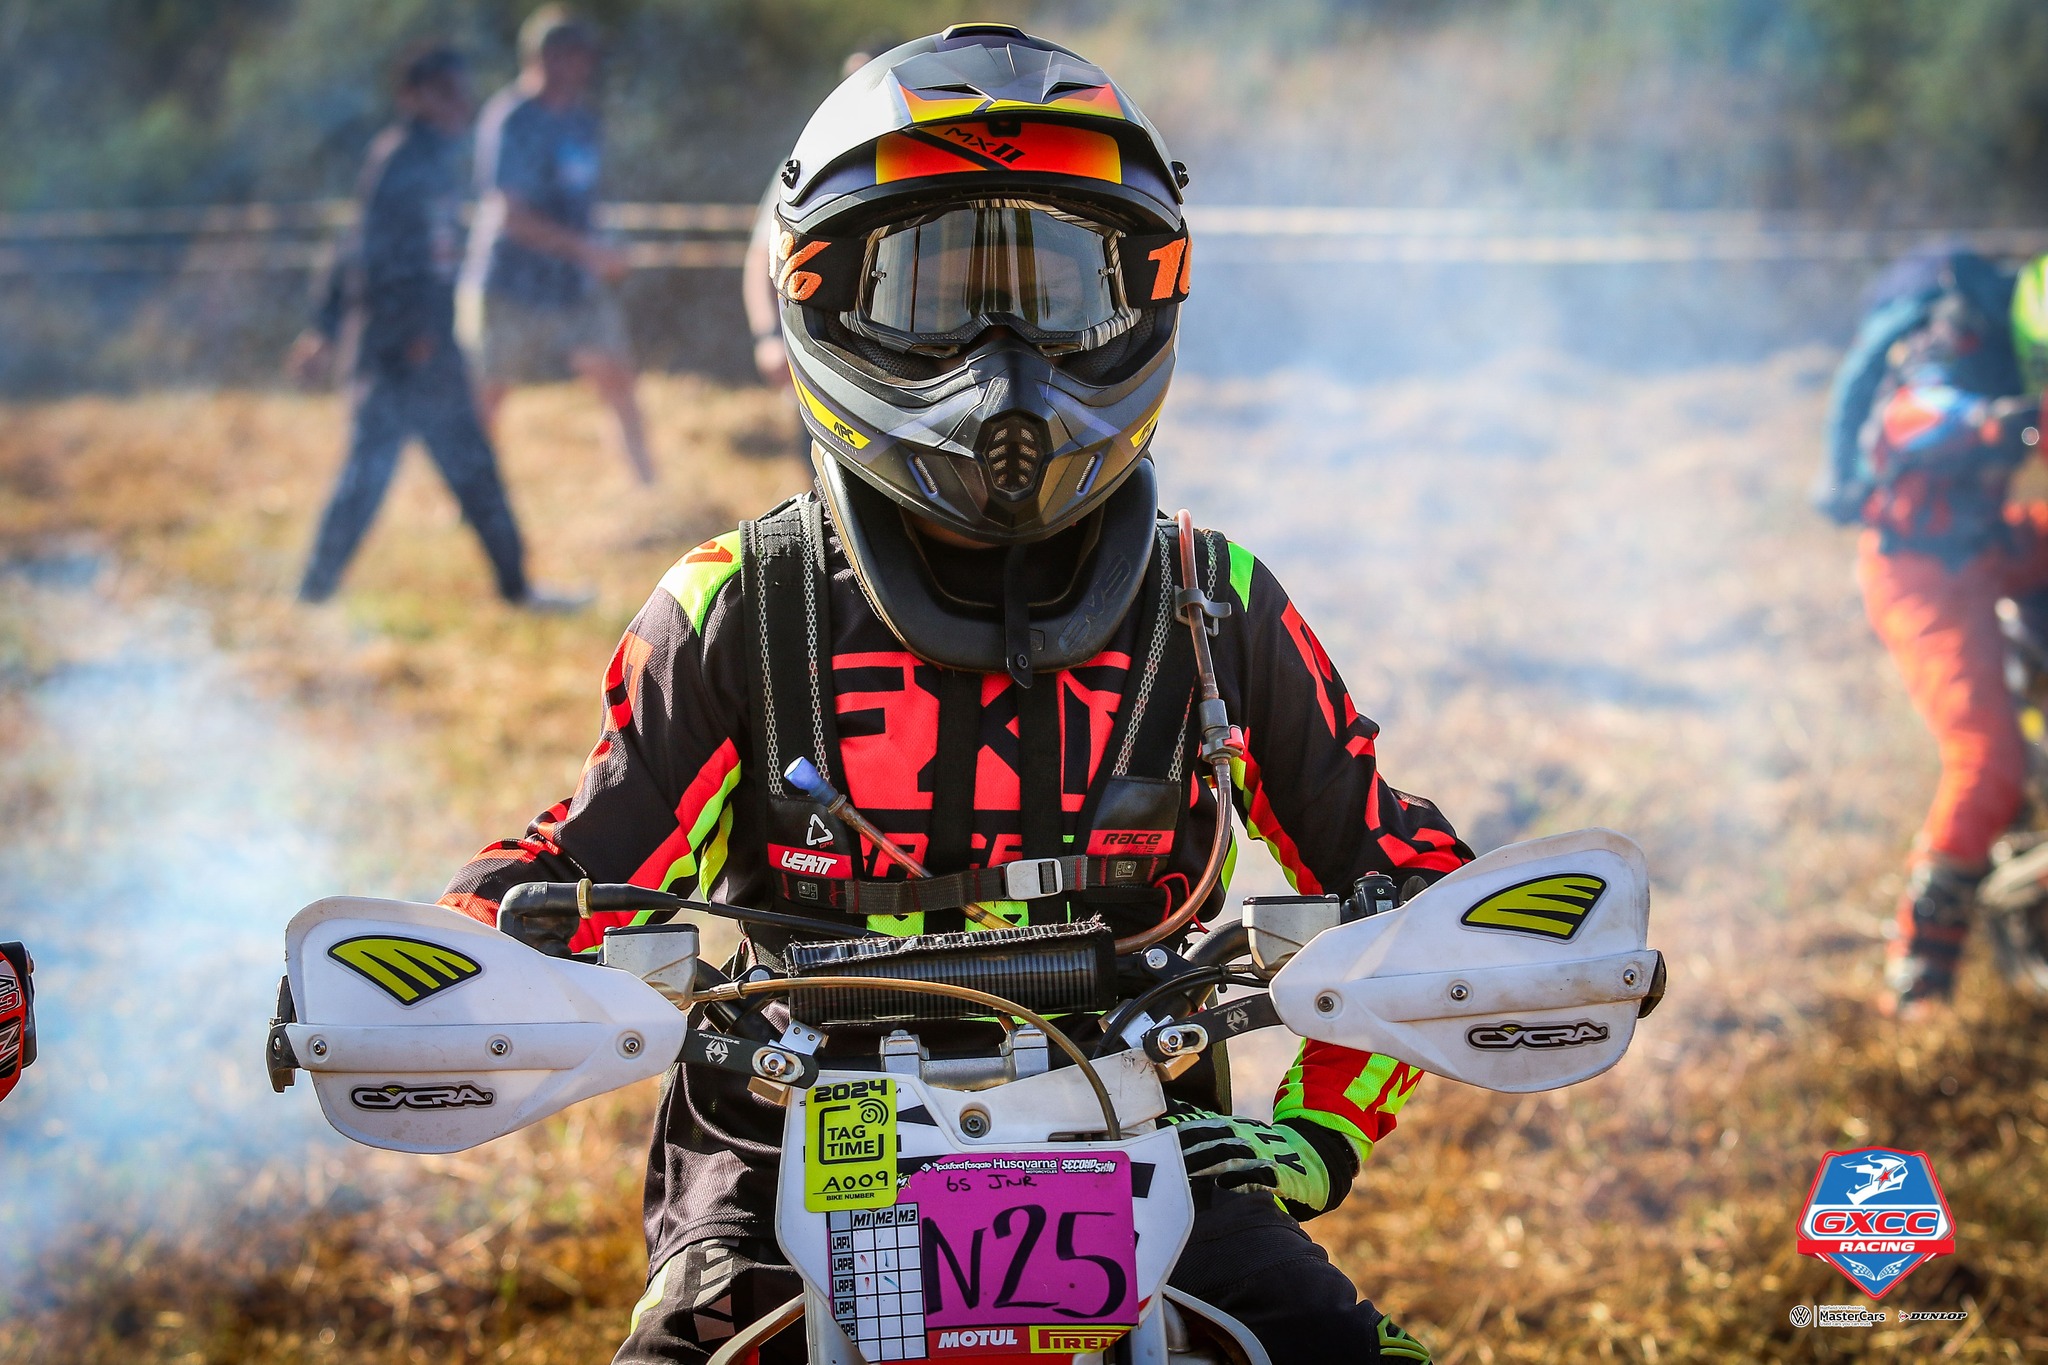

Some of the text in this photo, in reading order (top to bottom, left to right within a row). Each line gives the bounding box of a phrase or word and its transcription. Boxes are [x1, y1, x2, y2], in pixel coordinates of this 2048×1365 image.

[781, 850, 838, 875] LEATT
[814, 1080, 888, 1103] 2024
[827, 1125, 866, 1141] TAG
[827, 1140, 875, 1157] TIME
[993, 1158, 1057, 1173] Husqvarna
[823, 1170, 889, 1192] A009
[845, 1192, 875, 1200] NUMBER
[853, 1209, 917, 1227] M1 M2 M3
[832, 1235, 851, 1250] LAP1
[833, 1257, 853, 1271] LAP2
[834, 1279, 854, 1293] LAP3
[938, 1329, 1018, 1348] MOTUL
